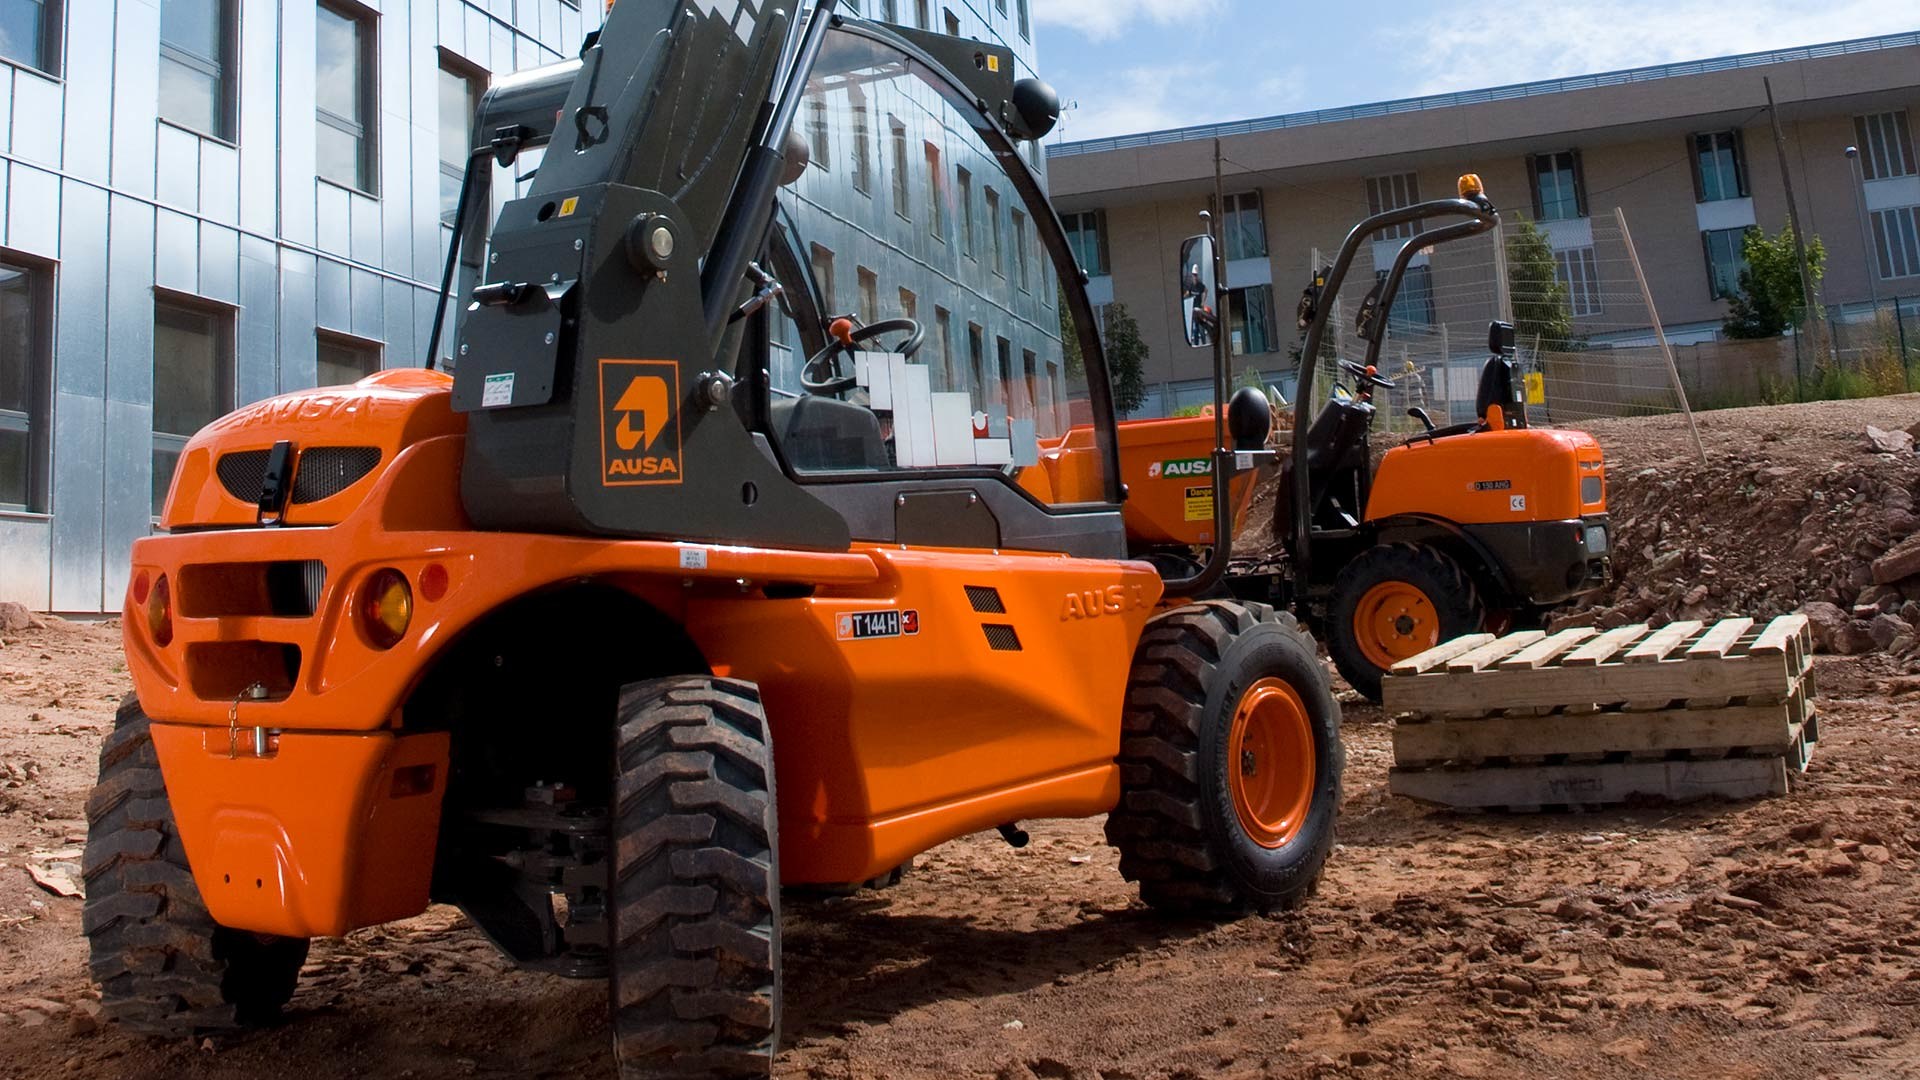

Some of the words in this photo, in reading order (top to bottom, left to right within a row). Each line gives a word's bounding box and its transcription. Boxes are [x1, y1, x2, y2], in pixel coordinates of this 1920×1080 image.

[243, 392, 376, 428] AUSA
[608, 457, 677, 475] AUSA
[1190, 488, 1213, 497] Dange
[1511, 498, 1524, 508] CE
[853, 615, 862, 636] T
[865, 613, 886, 634] 144
[887, 613, 898, 633] H
